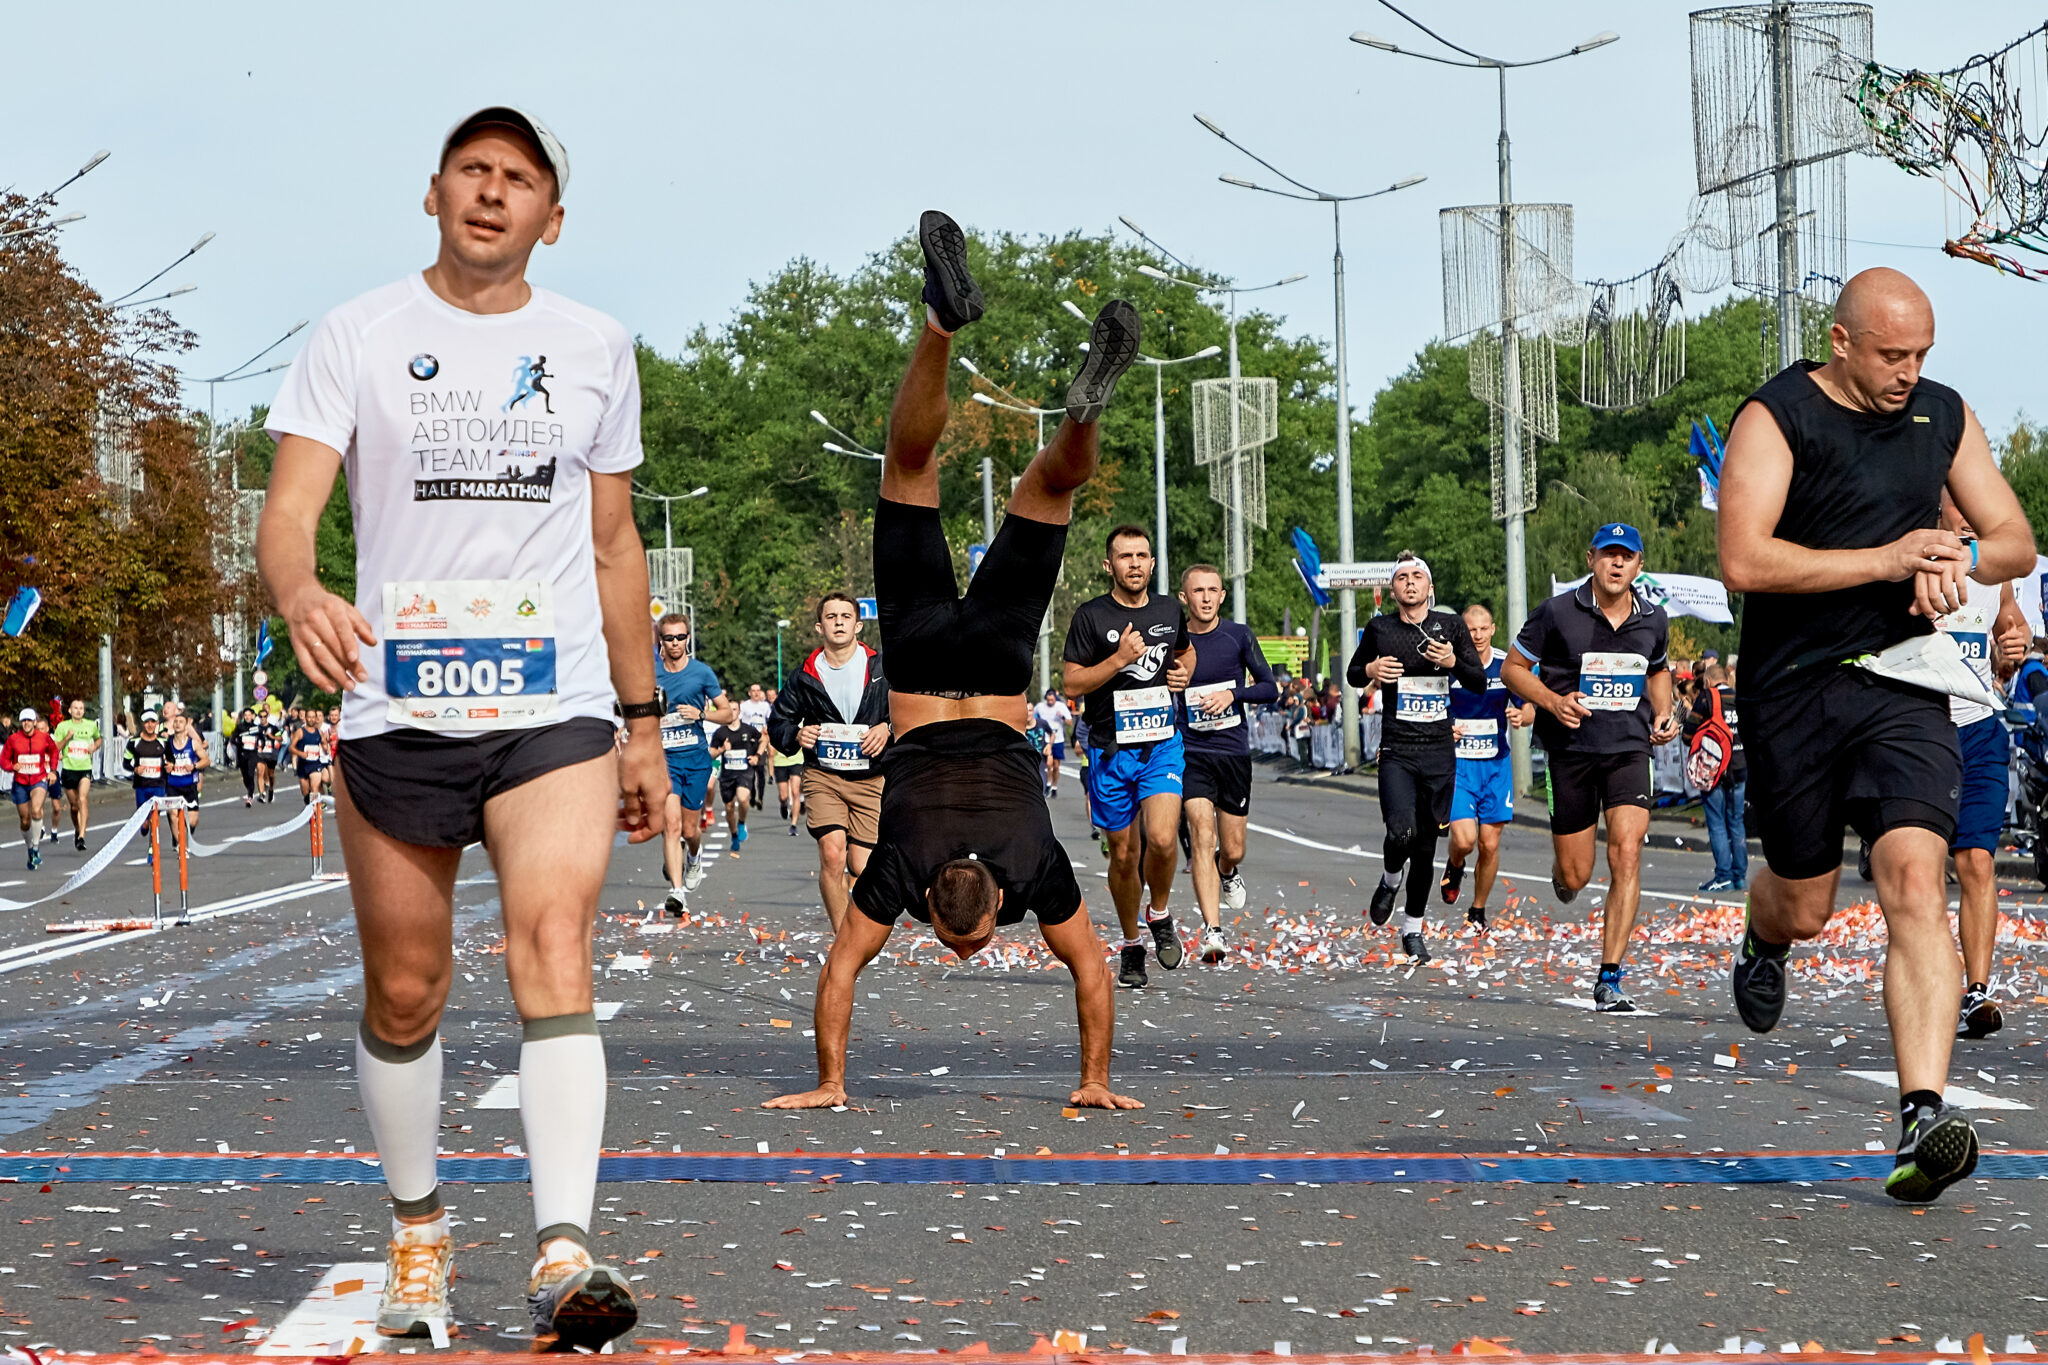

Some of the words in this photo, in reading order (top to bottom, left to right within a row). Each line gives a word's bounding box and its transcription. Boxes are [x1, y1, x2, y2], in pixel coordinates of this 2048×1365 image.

[410, 390, 482, 415] BMW
[411, 418, 563, 447] АВТОИДЕЯ
[412, 448, 490, 472] TEAM
[415, 480, 550, 500] HALFMARATHON
[417, 658, 525, 696] 8005
[1592, 682, 1634, 698] 9289
[1403, 699, 1446, 712] 10136
[1122, 713, 1168, 731] 11807
[1459, 738, 1493, 749] 12955
[826, 747, 859, 760] 8741
